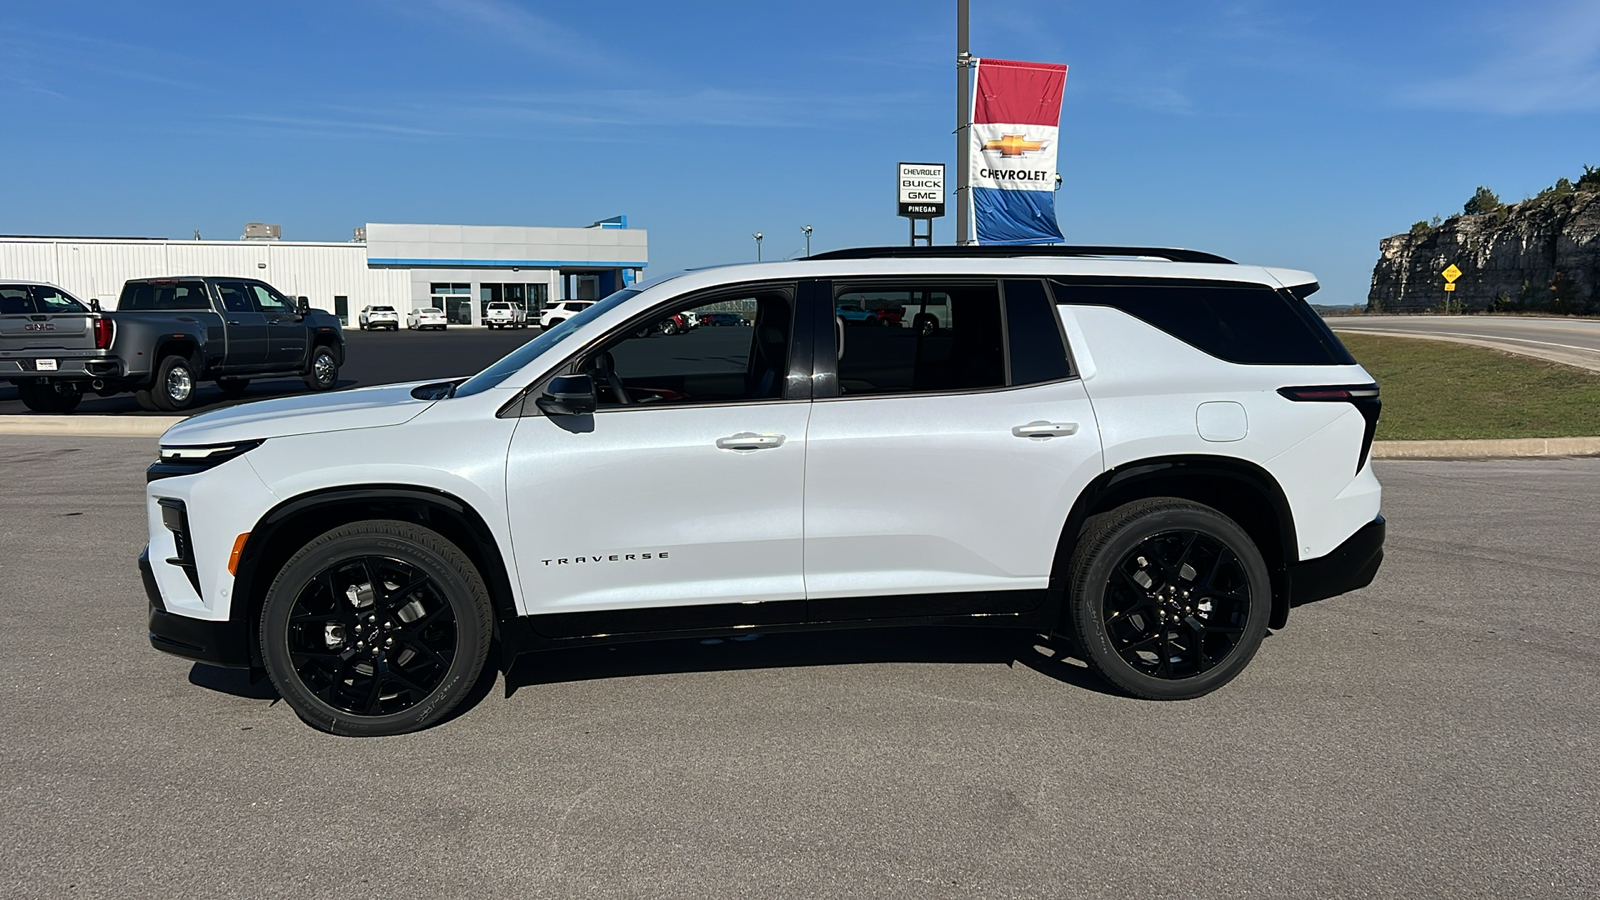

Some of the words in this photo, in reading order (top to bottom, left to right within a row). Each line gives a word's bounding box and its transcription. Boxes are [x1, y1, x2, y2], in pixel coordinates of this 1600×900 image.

[980, 168, 1047, 181] CHEVROLET
[902, 180, 942, 188] BUICK
[908, 192, 937, 200] GMC
[24, 323, 56, 331] GMC
[377, 540, 456, 585] CONTINENTAL
[541, 552, 669, 566] TRAVERSE
